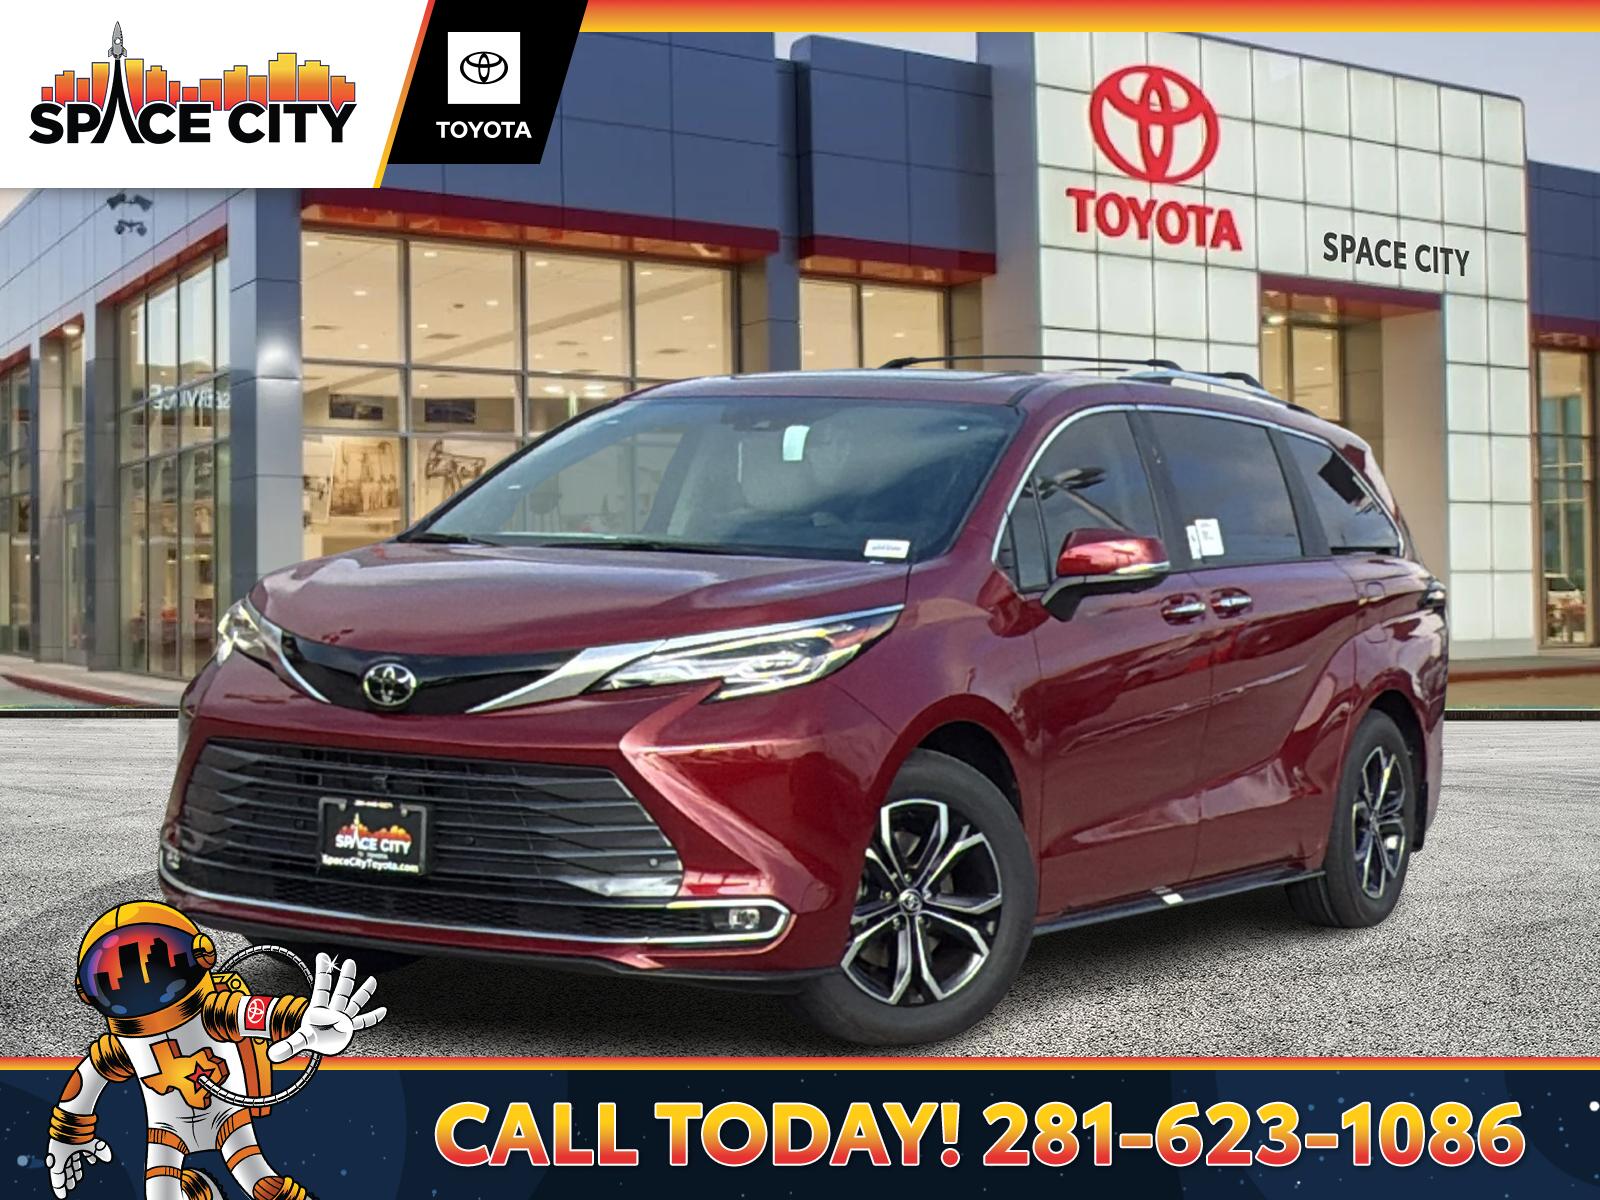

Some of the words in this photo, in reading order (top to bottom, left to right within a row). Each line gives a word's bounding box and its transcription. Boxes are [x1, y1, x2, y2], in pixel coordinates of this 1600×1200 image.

[1066, 187, 1242, 251] TOYOTA
[1323, 232, 1407, 269] SPACE
[1415, 244, 1470, 277] CITY
[335, 825, 378, 851] SPACE
[380, 838, 412, 855] CITY
